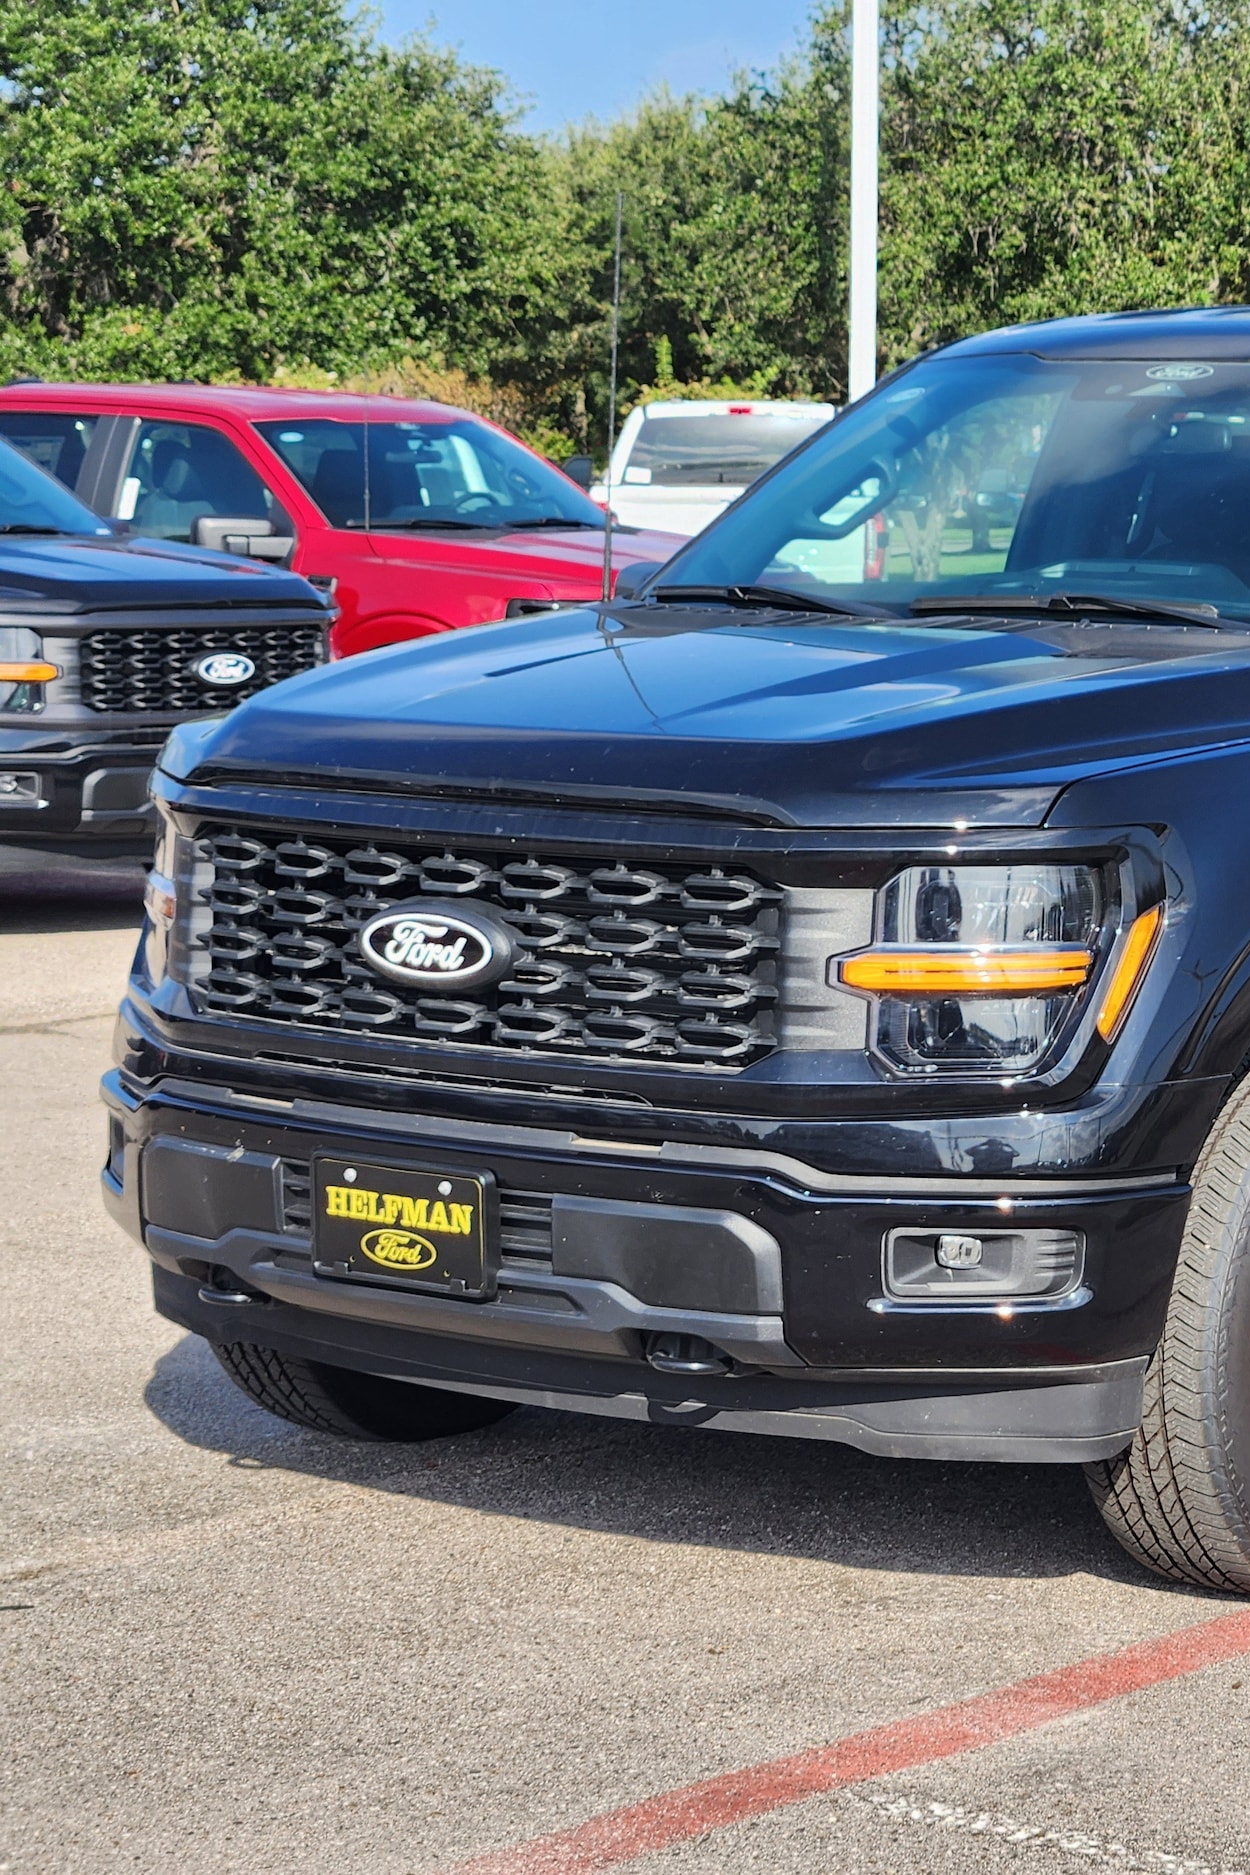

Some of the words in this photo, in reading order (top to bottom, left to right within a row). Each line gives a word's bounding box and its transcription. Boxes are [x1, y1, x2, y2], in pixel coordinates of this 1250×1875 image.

[205, 658, 247, 679] Ford
[384, 920, 468, 970] Ford
[325, 1185, 474, 1235] HELFMAN
[374, 1232, 422, 1264] Ford
